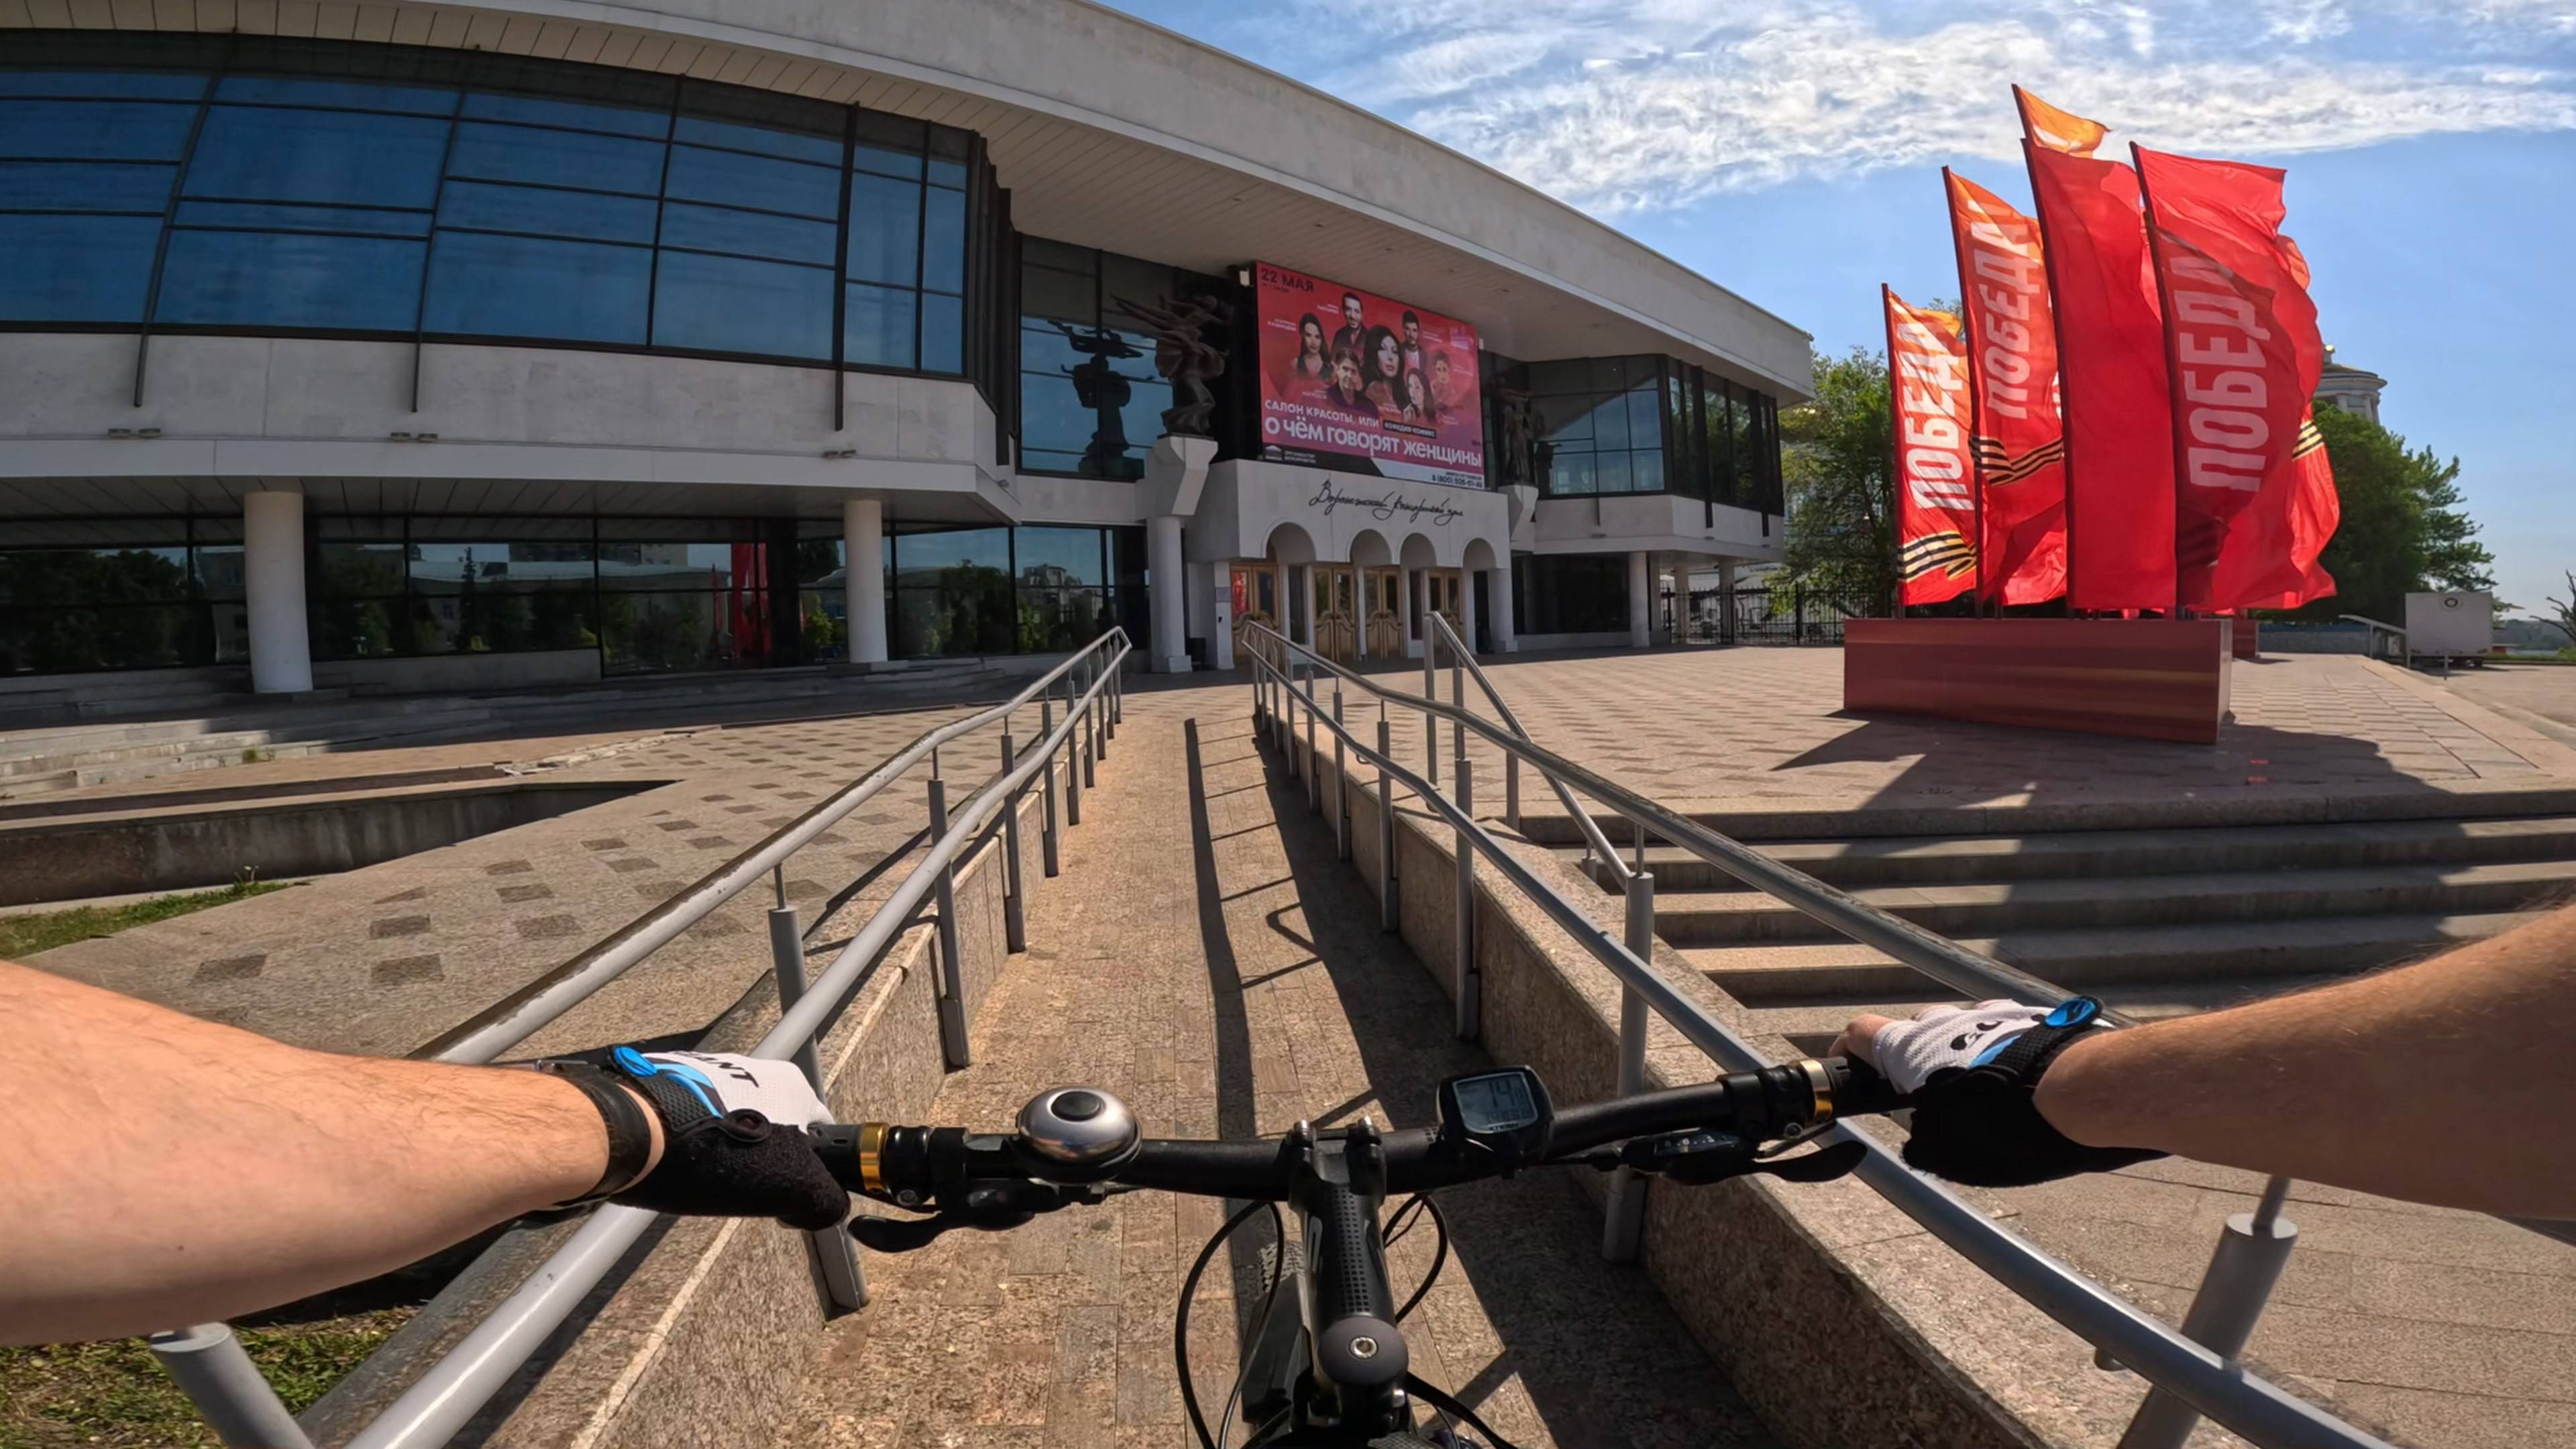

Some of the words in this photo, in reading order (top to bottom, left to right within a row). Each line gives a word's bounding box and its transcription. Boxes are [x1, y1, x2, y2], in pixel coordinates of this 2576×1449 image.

[1261, 268, 1278, 283] 22
[1282, 274, 1314, 293] МАЯ
[2157, 235, 2271, 492] ПОБЕДА
[1265, 399, 1304, 415] САЛОН
[1306, 407, 1355, 425] КРАСОТЫ,
[1358, 415, 1380, 427] ИЛИ
[1265, 416, 1281, 435] О
